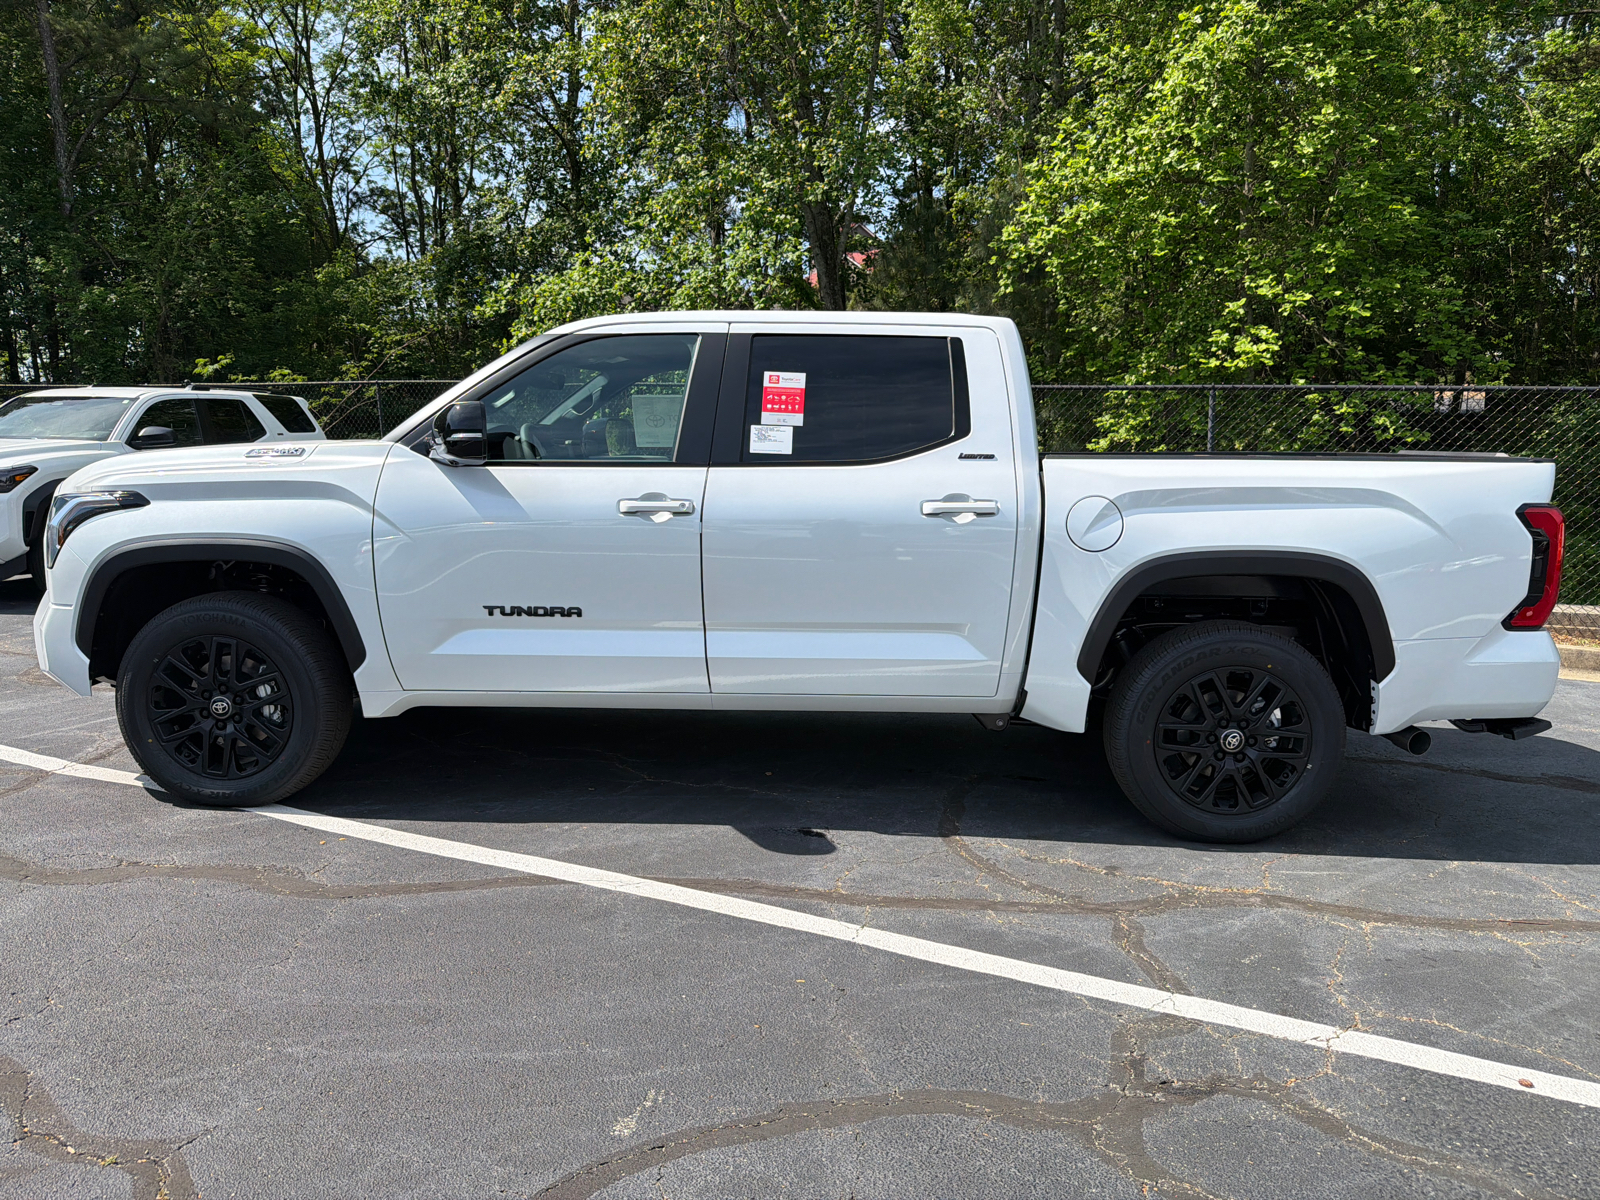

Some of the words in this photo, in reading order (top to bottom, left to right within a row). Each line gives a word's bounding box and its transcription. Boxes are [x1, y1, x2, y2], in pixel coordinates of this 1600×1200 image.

[482, 605, 582, 618] TUNDRA
[181, 613, 247, 629] YOKOHAMA
[1136, 647, 1222, 725] GEOLANDAR
